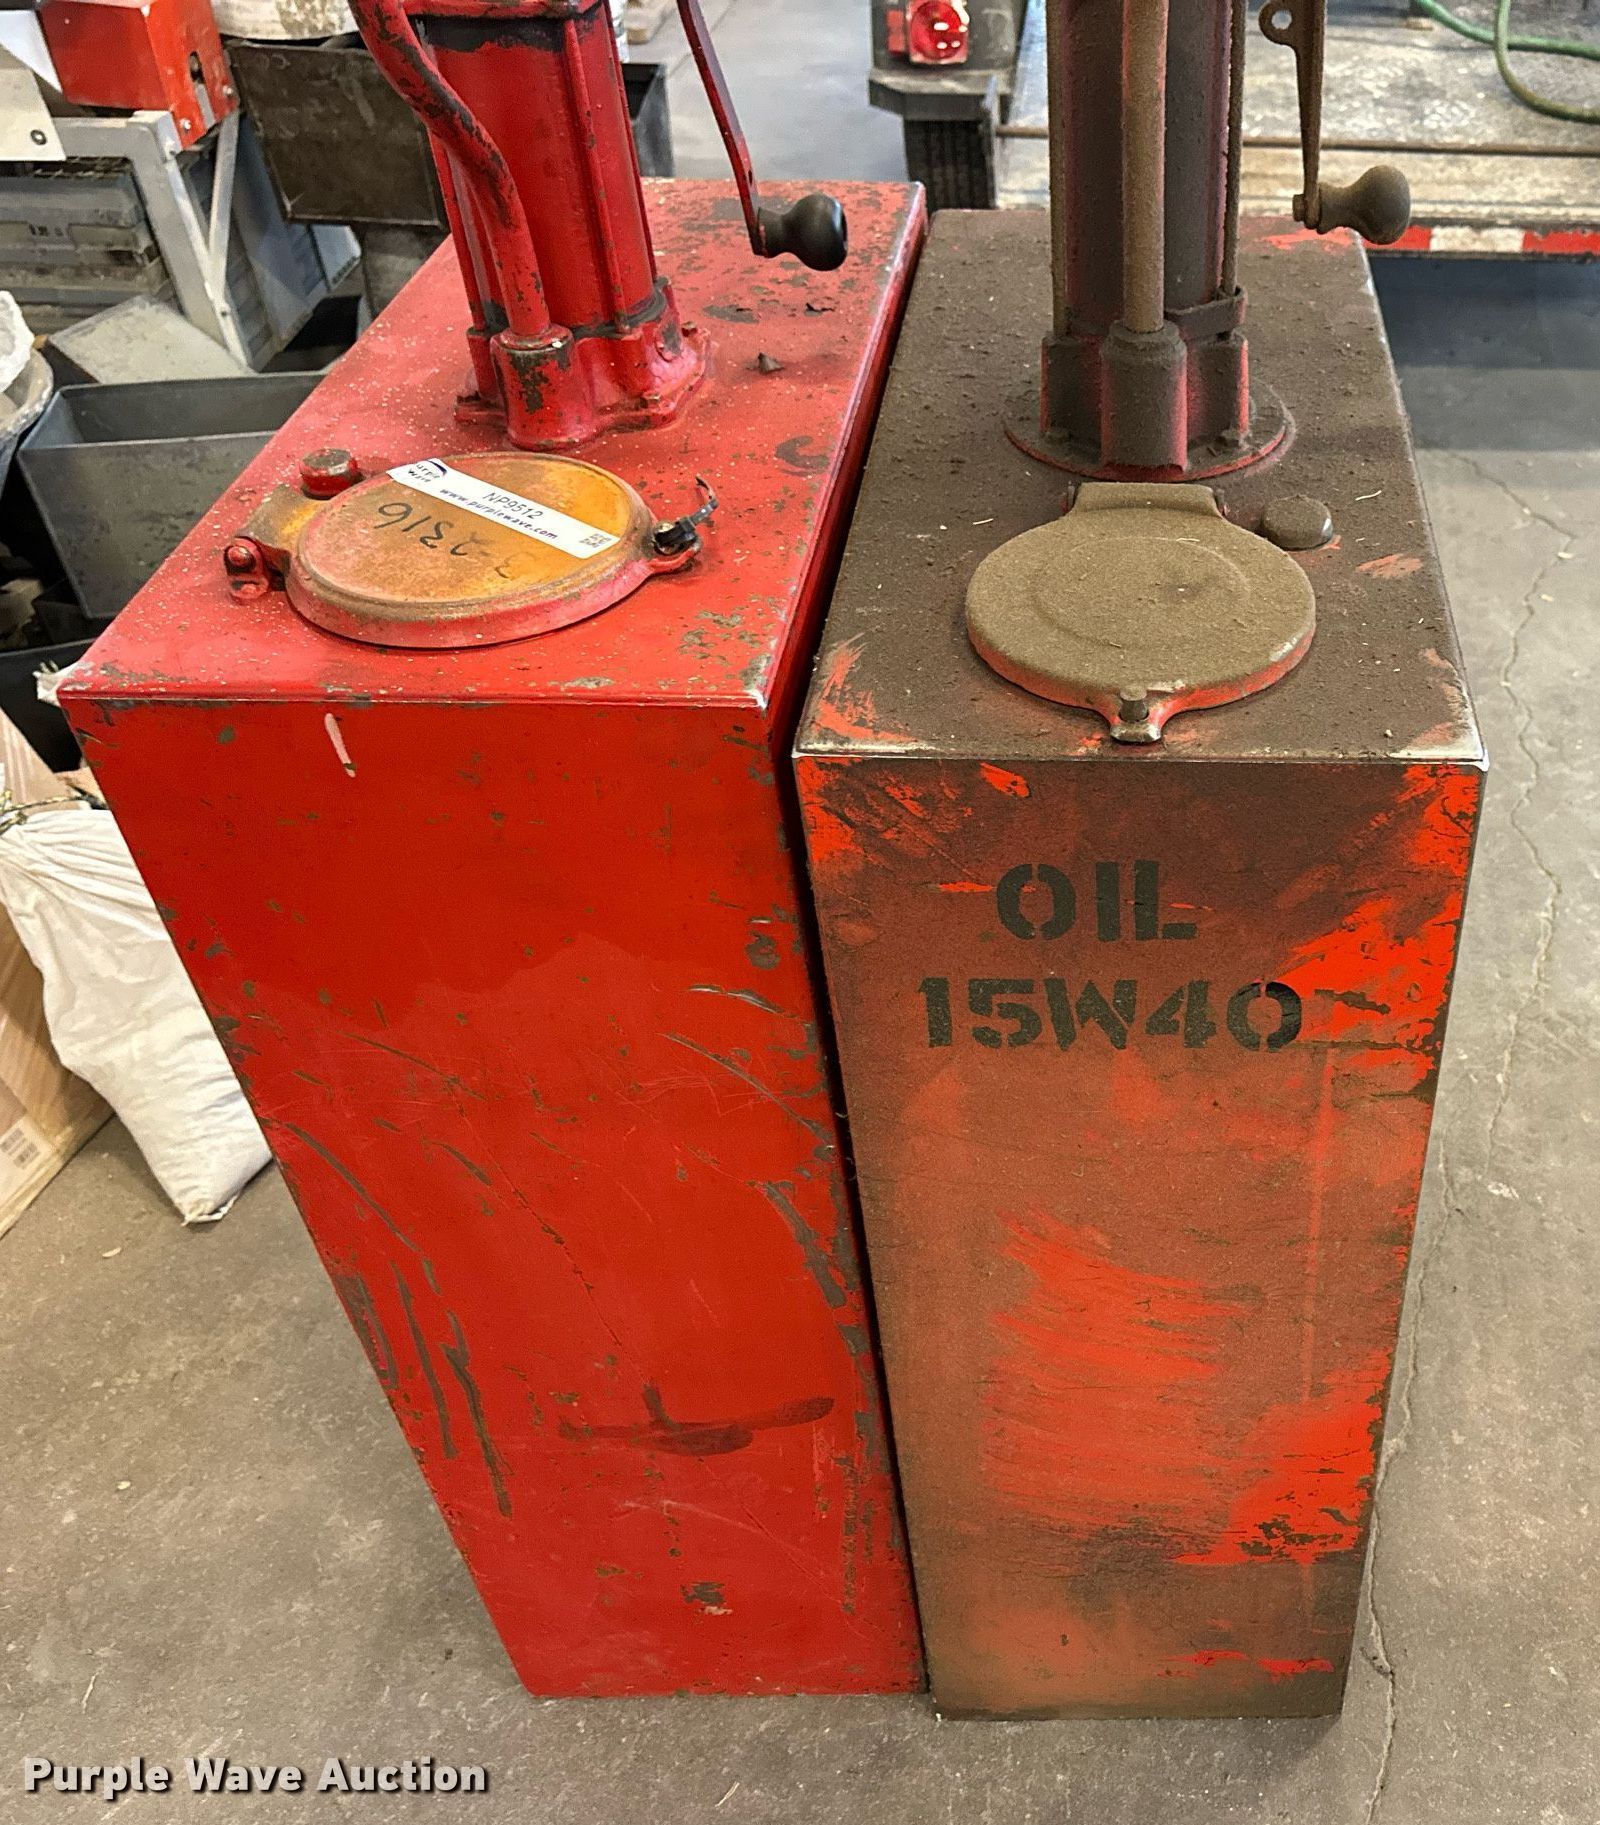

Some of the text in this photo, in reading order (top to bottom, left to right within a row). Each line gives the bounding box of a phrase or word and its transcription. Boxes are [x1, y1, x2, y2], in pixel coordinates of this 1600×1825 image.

[439, 488, 559, 539] www.purplewave.com
[483, 491, 544, 520] NP9512
[996, 860, 1197, 942] OIL
[918, 977, 1302, 1052] 15W40
